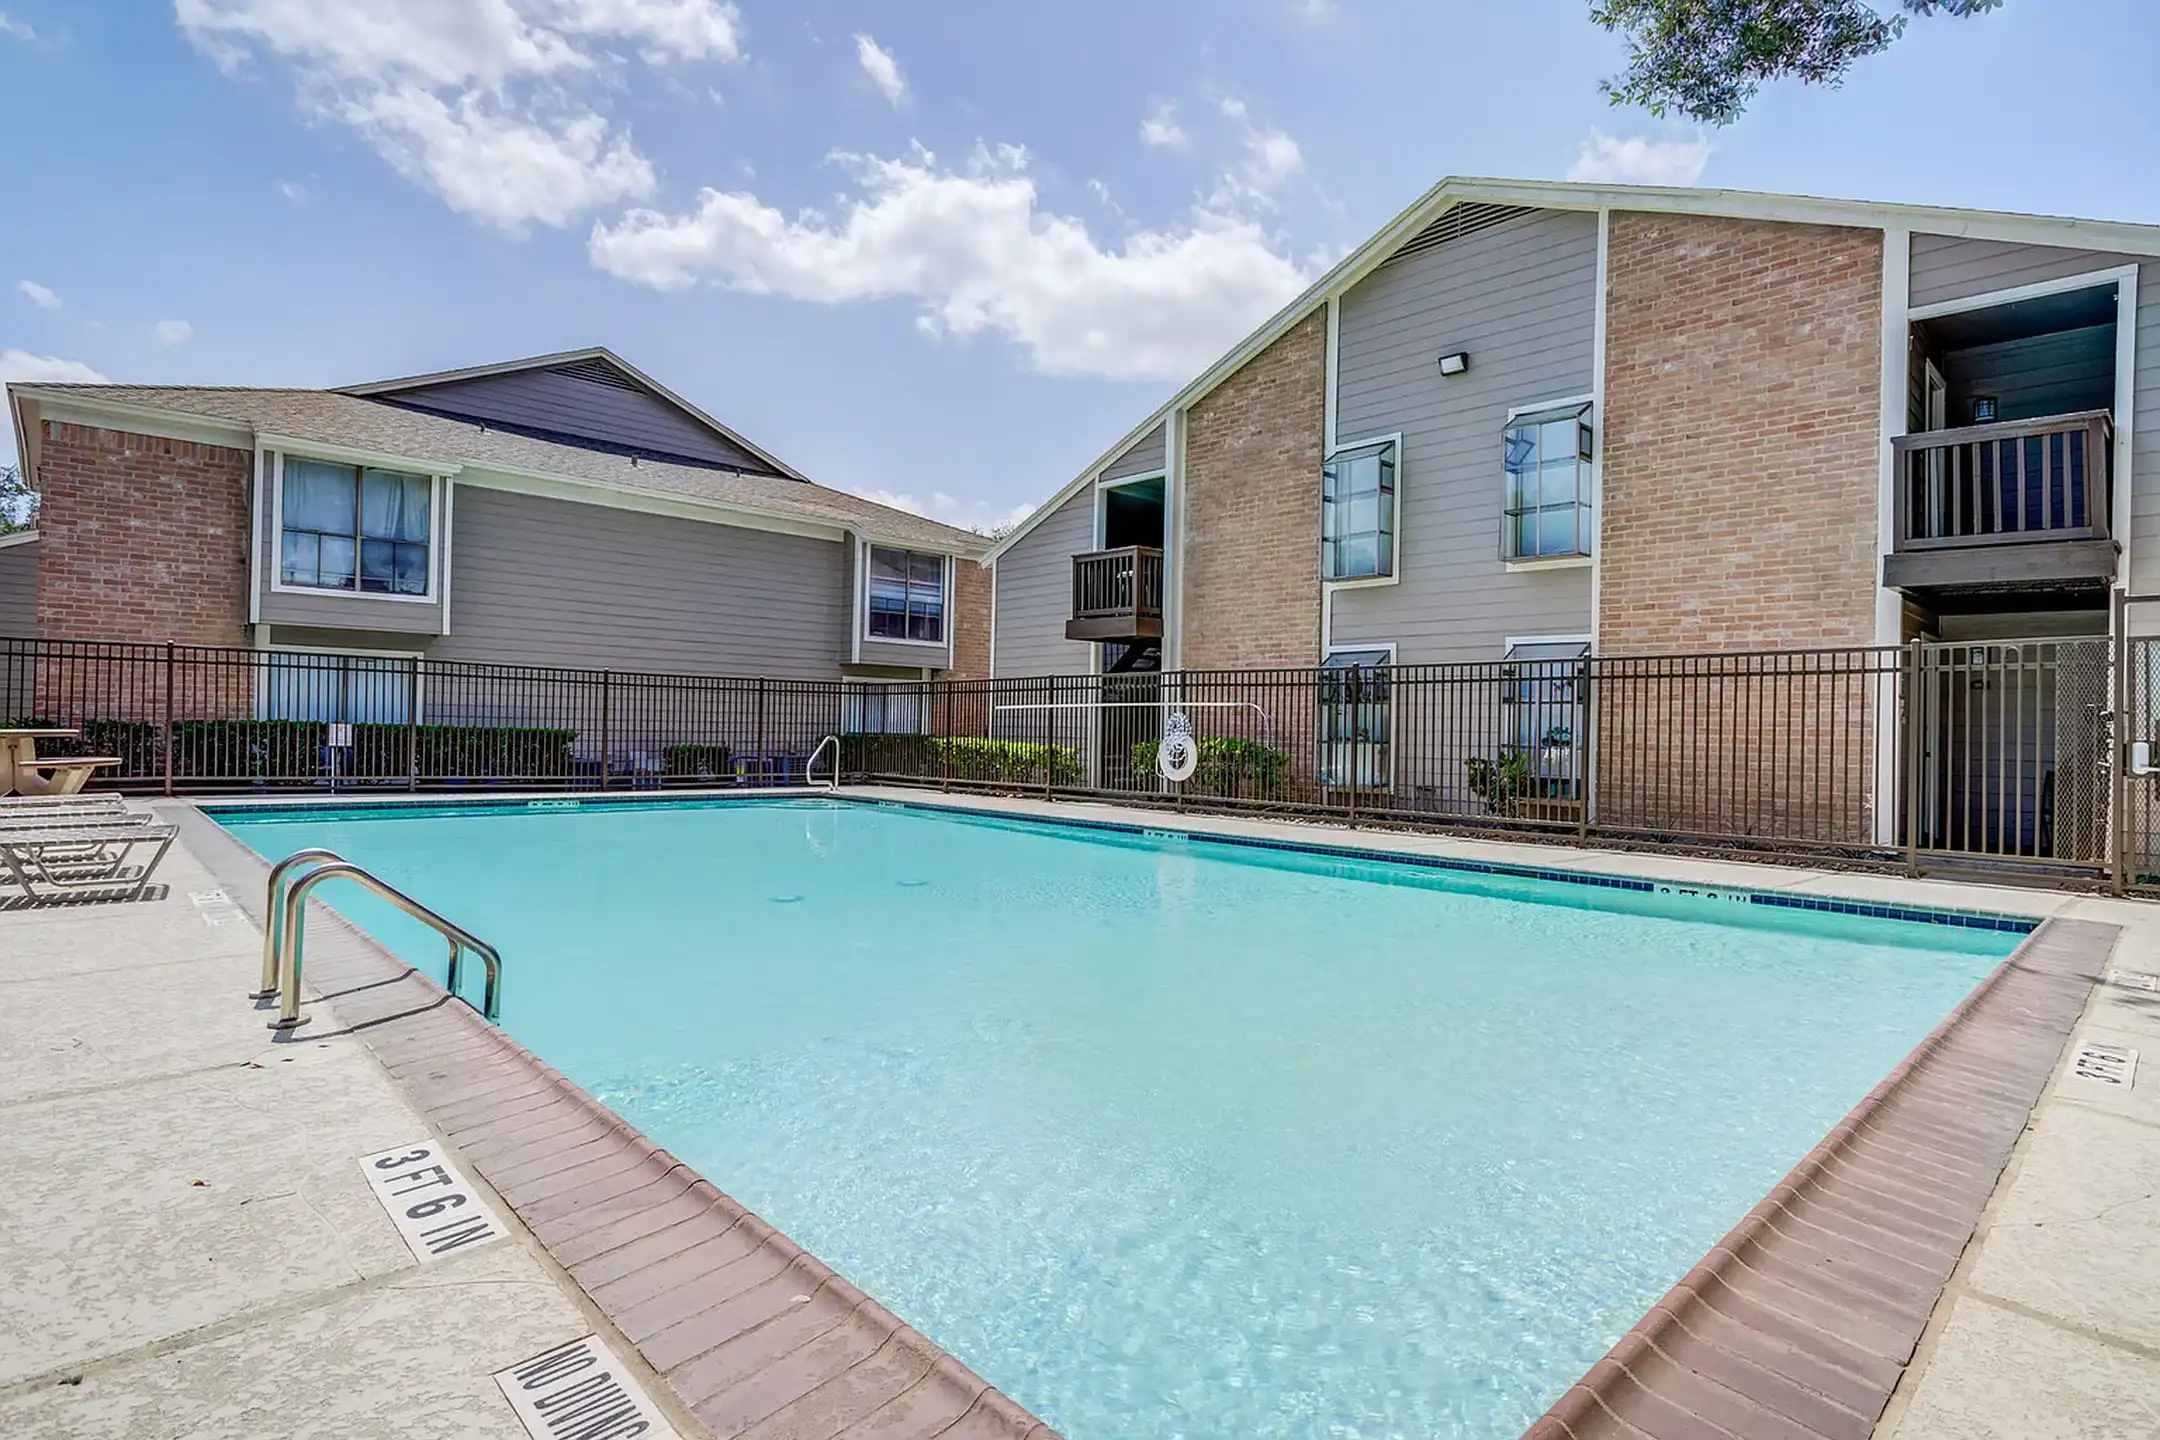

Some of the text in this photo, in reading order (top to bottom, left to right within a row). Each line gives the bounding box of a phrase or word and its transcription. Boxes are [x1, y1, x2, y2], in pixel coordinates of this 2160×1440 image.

[374, 1149, 495, 1255] 3 FT 6 IN
[512, 1343, 598, 1390] NO
